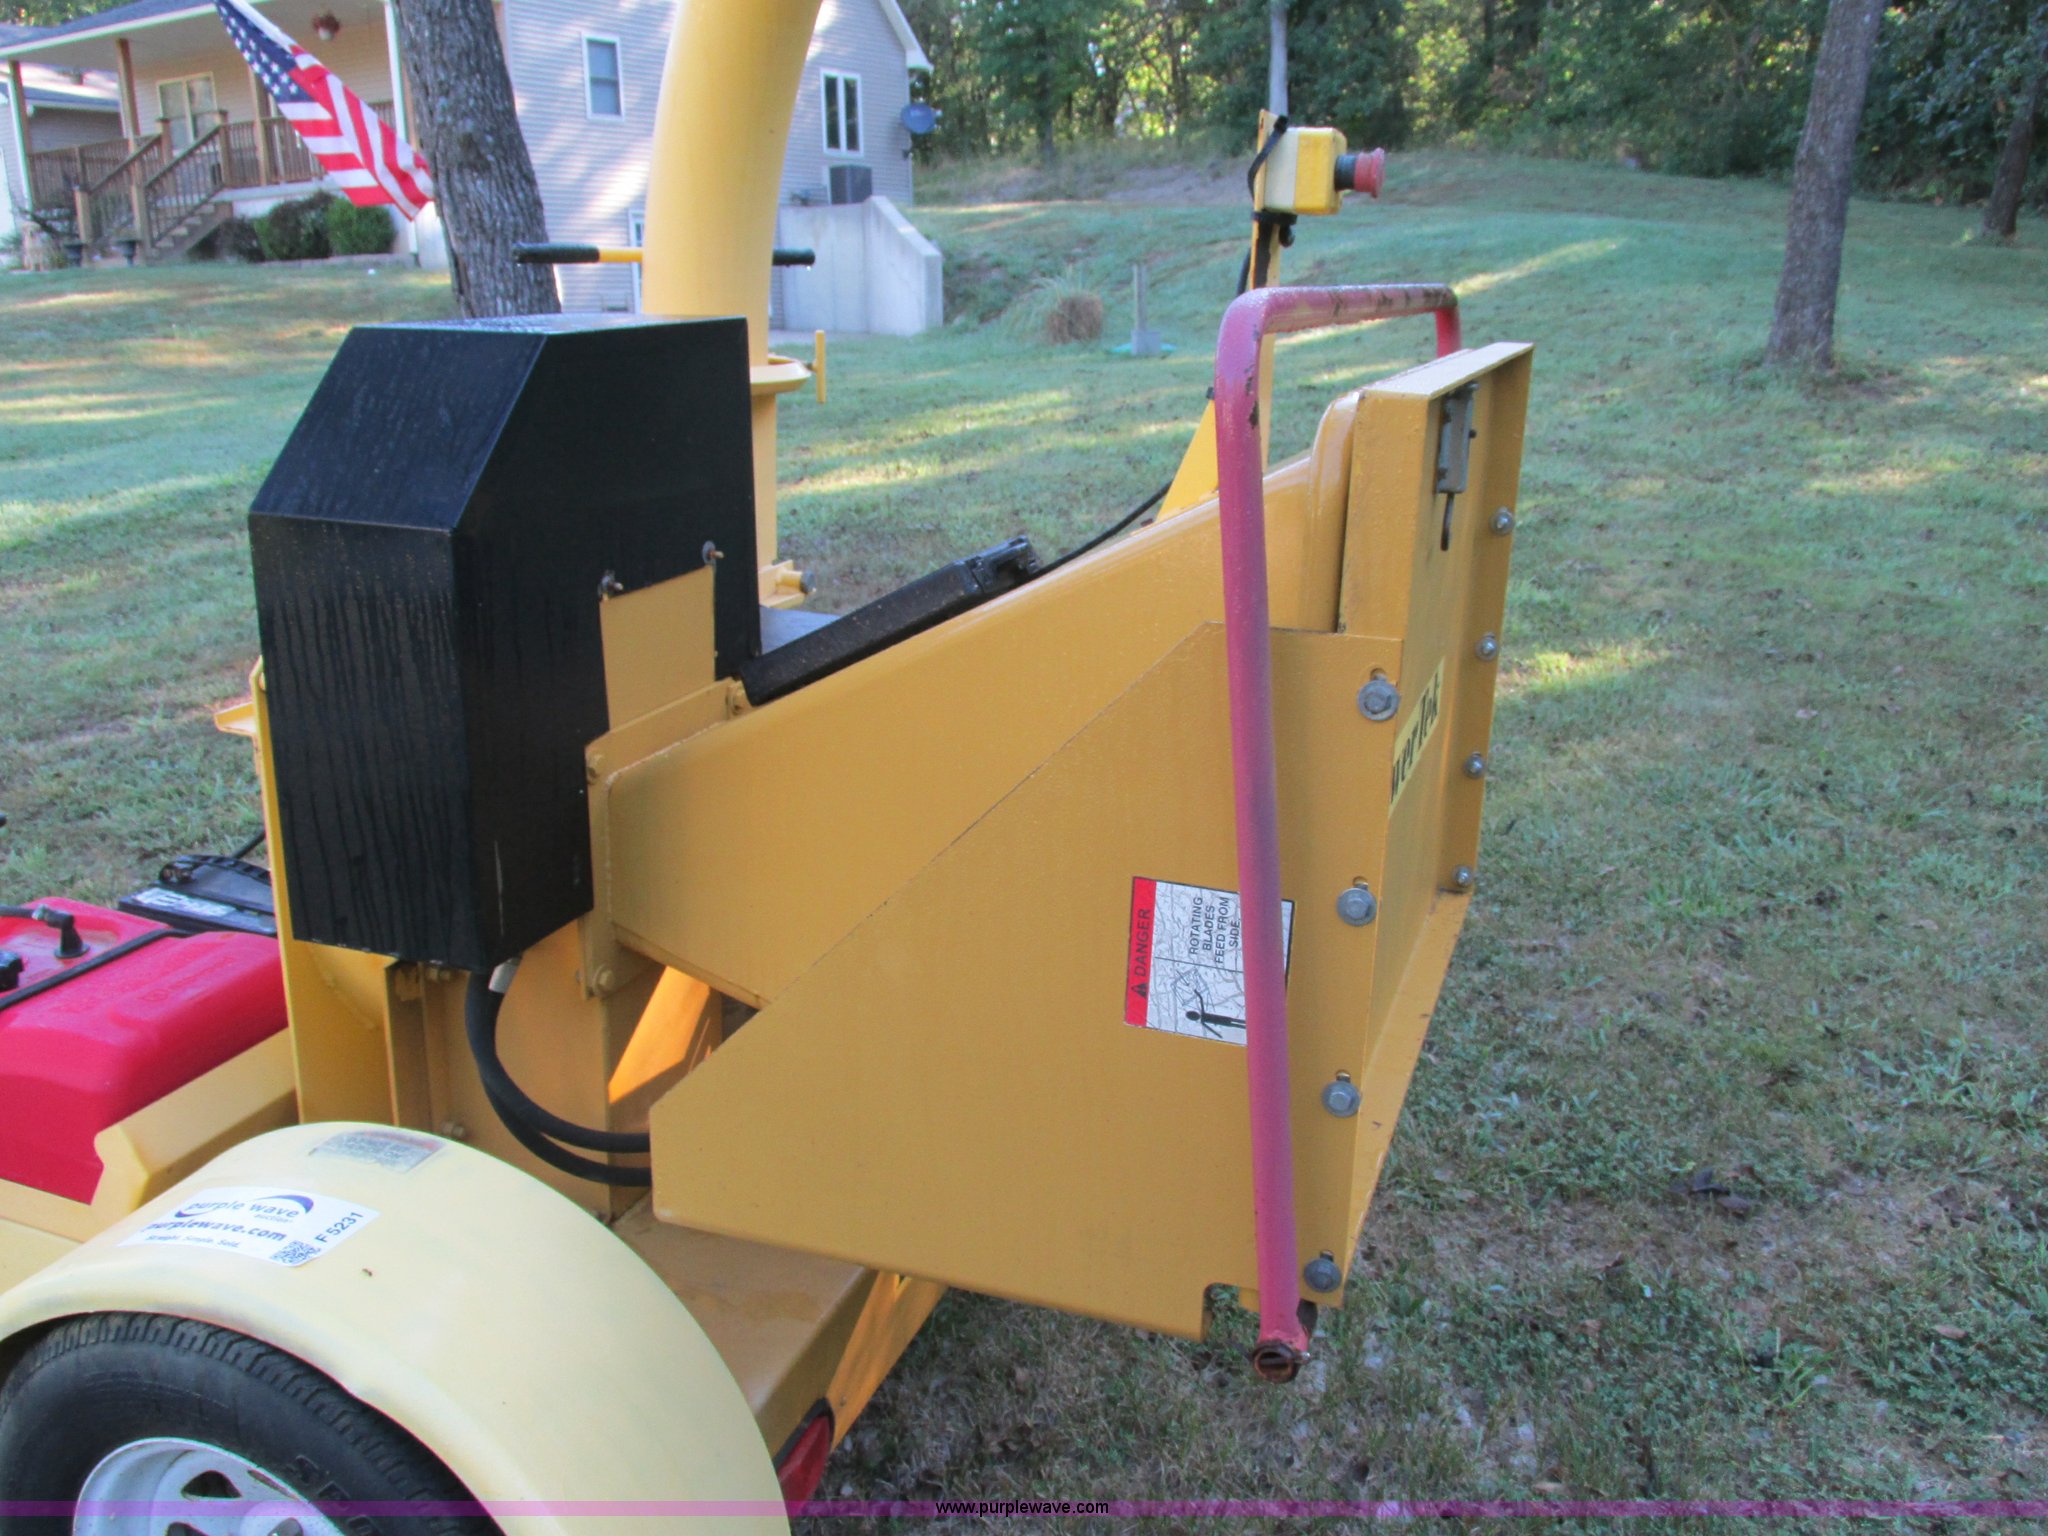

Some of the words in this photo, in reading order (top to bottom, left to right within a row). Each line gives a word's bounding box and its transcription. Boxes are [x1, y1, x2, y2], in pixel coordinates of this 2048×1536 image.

[1189, 897, 1203, 955] ROTATING
[1202, 905, 1215, 951] BLADES
[1217, 896, 1231, 932] FROM
[1135, 909, 1151, 977] DANGER
[1215, 933, 1226, 963] FEED
[185, 1201, 245, 1211] purple
[249, 1203, 299, 1218] wave
[141, 1219, 287, 1241] purplewave.com
[314, 1233, 327, 1243] F
[326, 1212, 364, 1236] 5231
